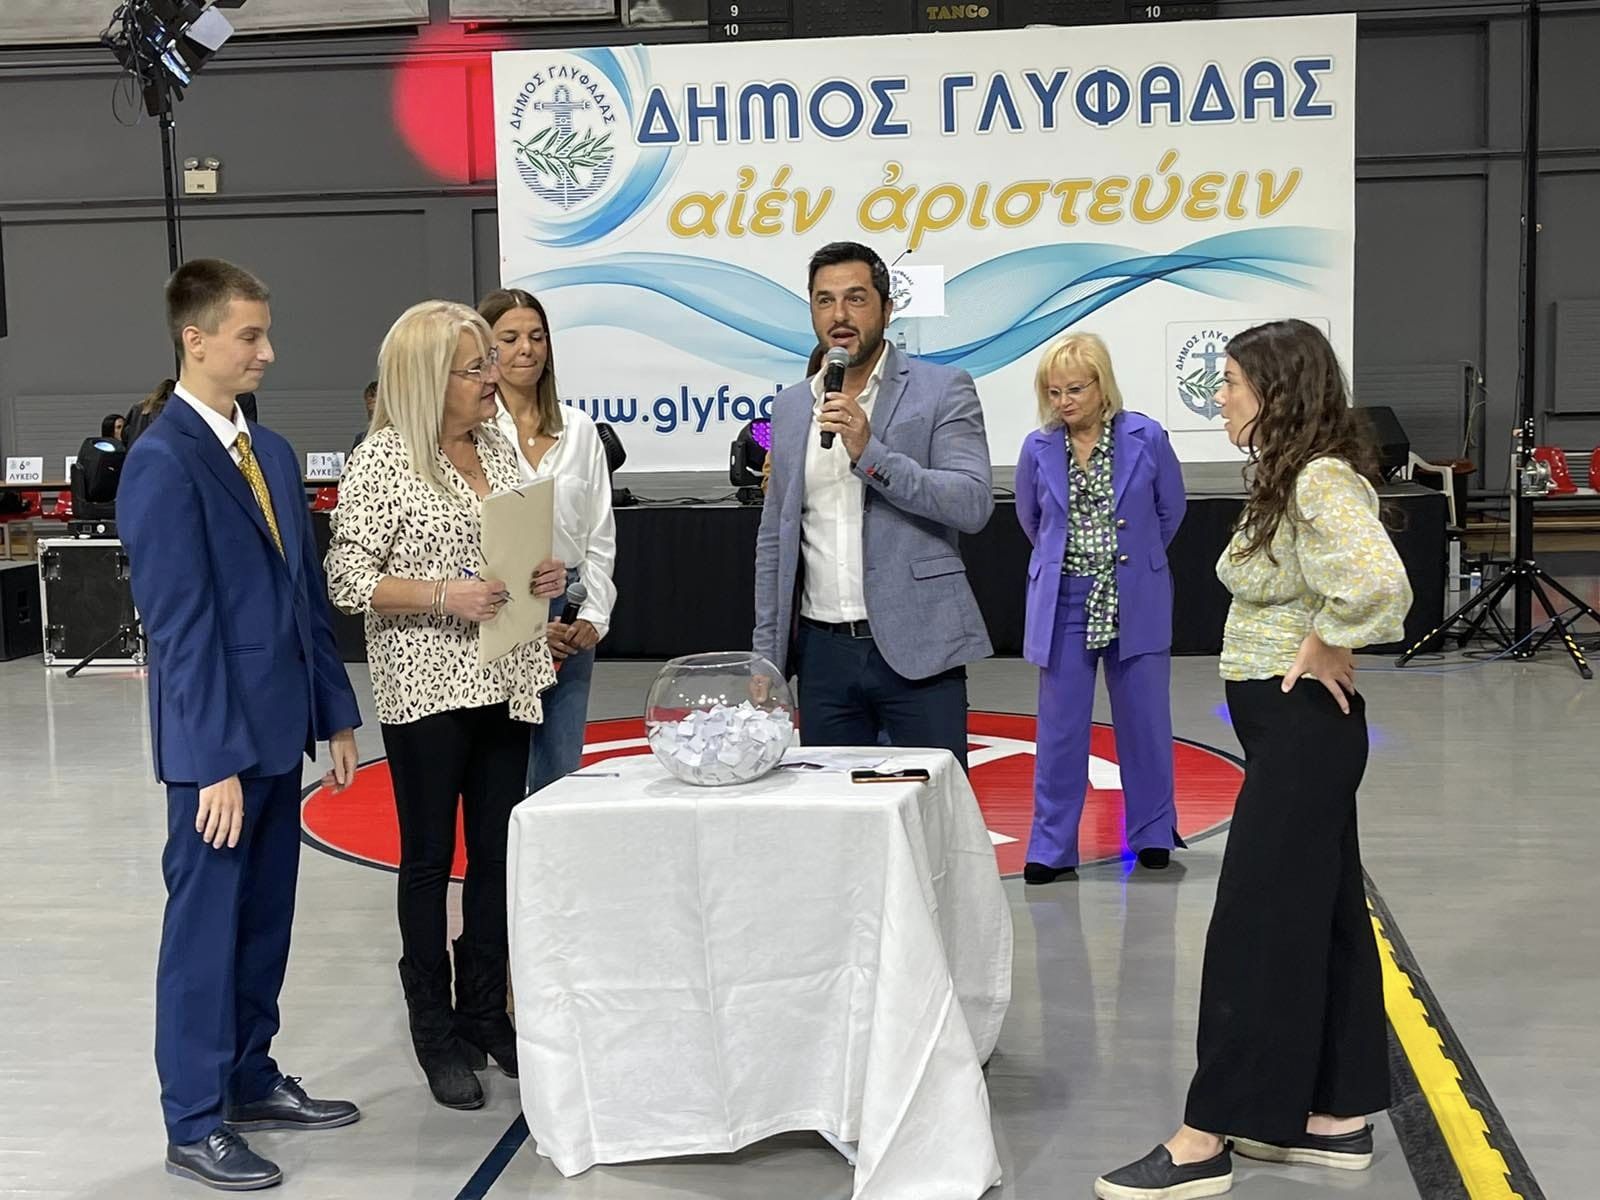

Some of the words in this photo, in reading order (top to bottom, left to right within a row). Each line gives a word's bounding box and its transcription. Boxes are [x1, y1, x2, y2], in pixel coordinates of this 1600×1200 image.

[730, 4, 739, 17] 9
[1145, 5, 1161, 18] 10
[723, 23, 739, 36] 10
[510, 73, 545, 130] ΔΗΜΟΣ
[548, 66, 616, 125] ΓΛΥΦΑΔΑΣ
[635, 78, 910, 144] ΔΗΜΟΣ
[942, 58, 1334, 135] ΓΛΥΦΑΔΑΣ
[1175, 335, 1200, 371] ΔΗΜΟΣ
[1201, 330, 1229, 343] ΓΛΥΦ
[310, 468, 342, 477] ΛΥΚΕΟ
